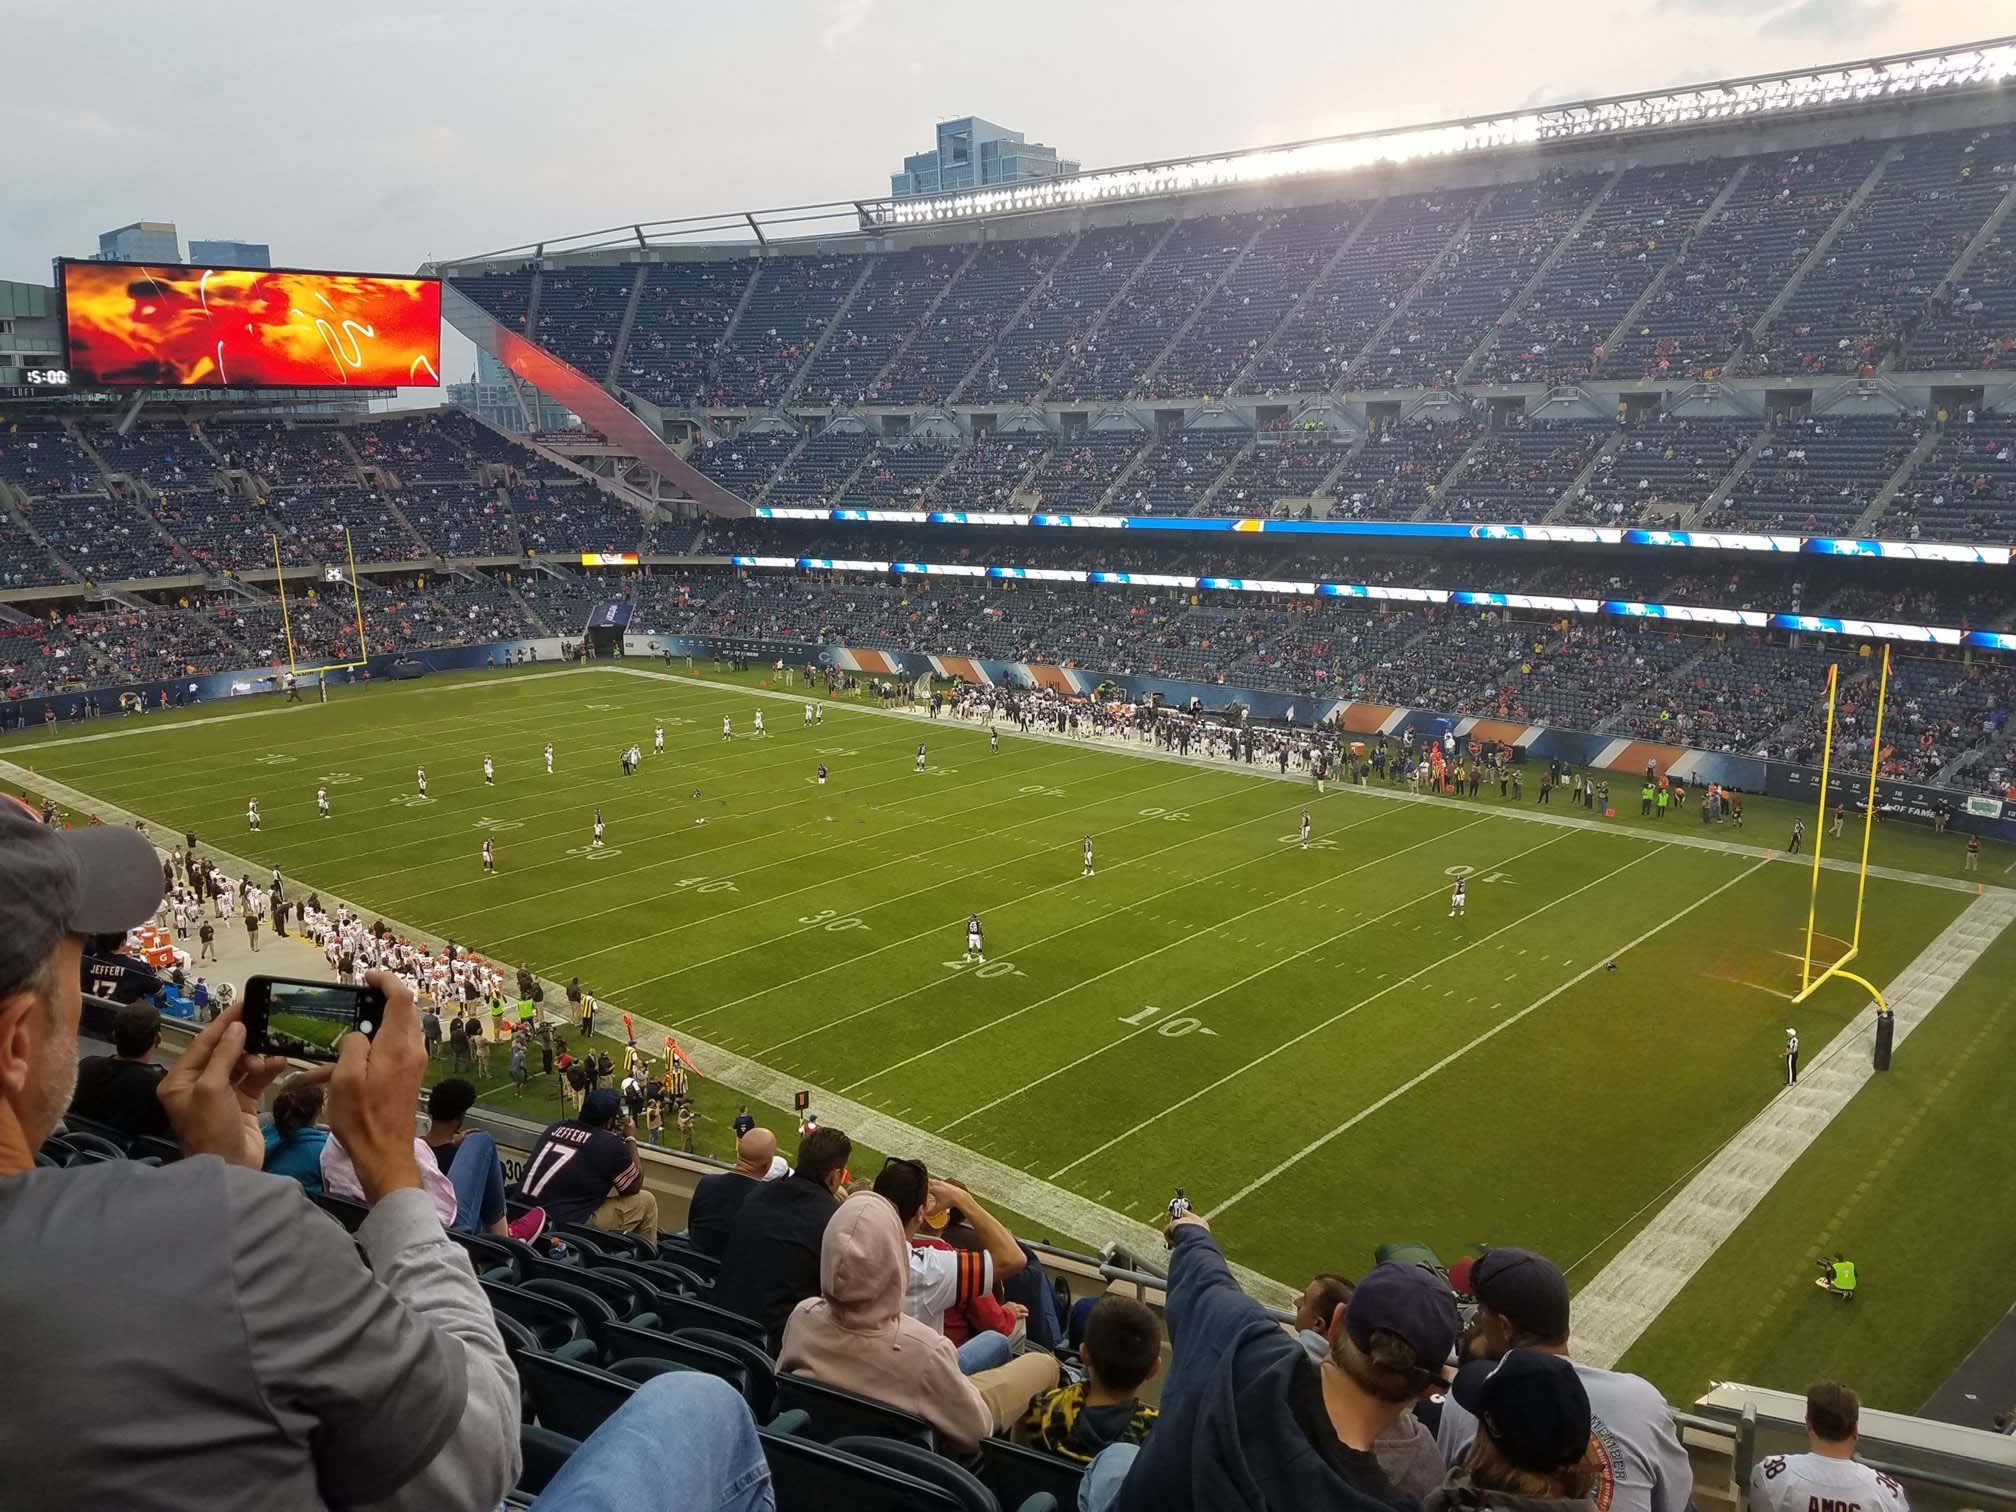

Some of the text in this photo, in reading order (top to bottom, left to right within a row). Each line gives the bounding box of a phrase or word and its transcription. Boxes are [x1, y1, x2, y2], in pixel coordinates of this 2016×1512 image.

[27, 370, 67, 384] 15:00
[1908, 807, 1950, 821] FAMES
[675, 877, 732, 893] 40
[798, 910, 863, 931] 30
[90, 965, 126, 976] JEFFERY
[942, 952, 1015, 978] 20
[92, 979, 117, 999] 17
[1118, 1006, 1201, 1038] 10
[551, 1126, 592, 1144] JEFFERY
[521, 1141, 578, 1198] 17
[1763, 1456, 1787, 1480] 38
